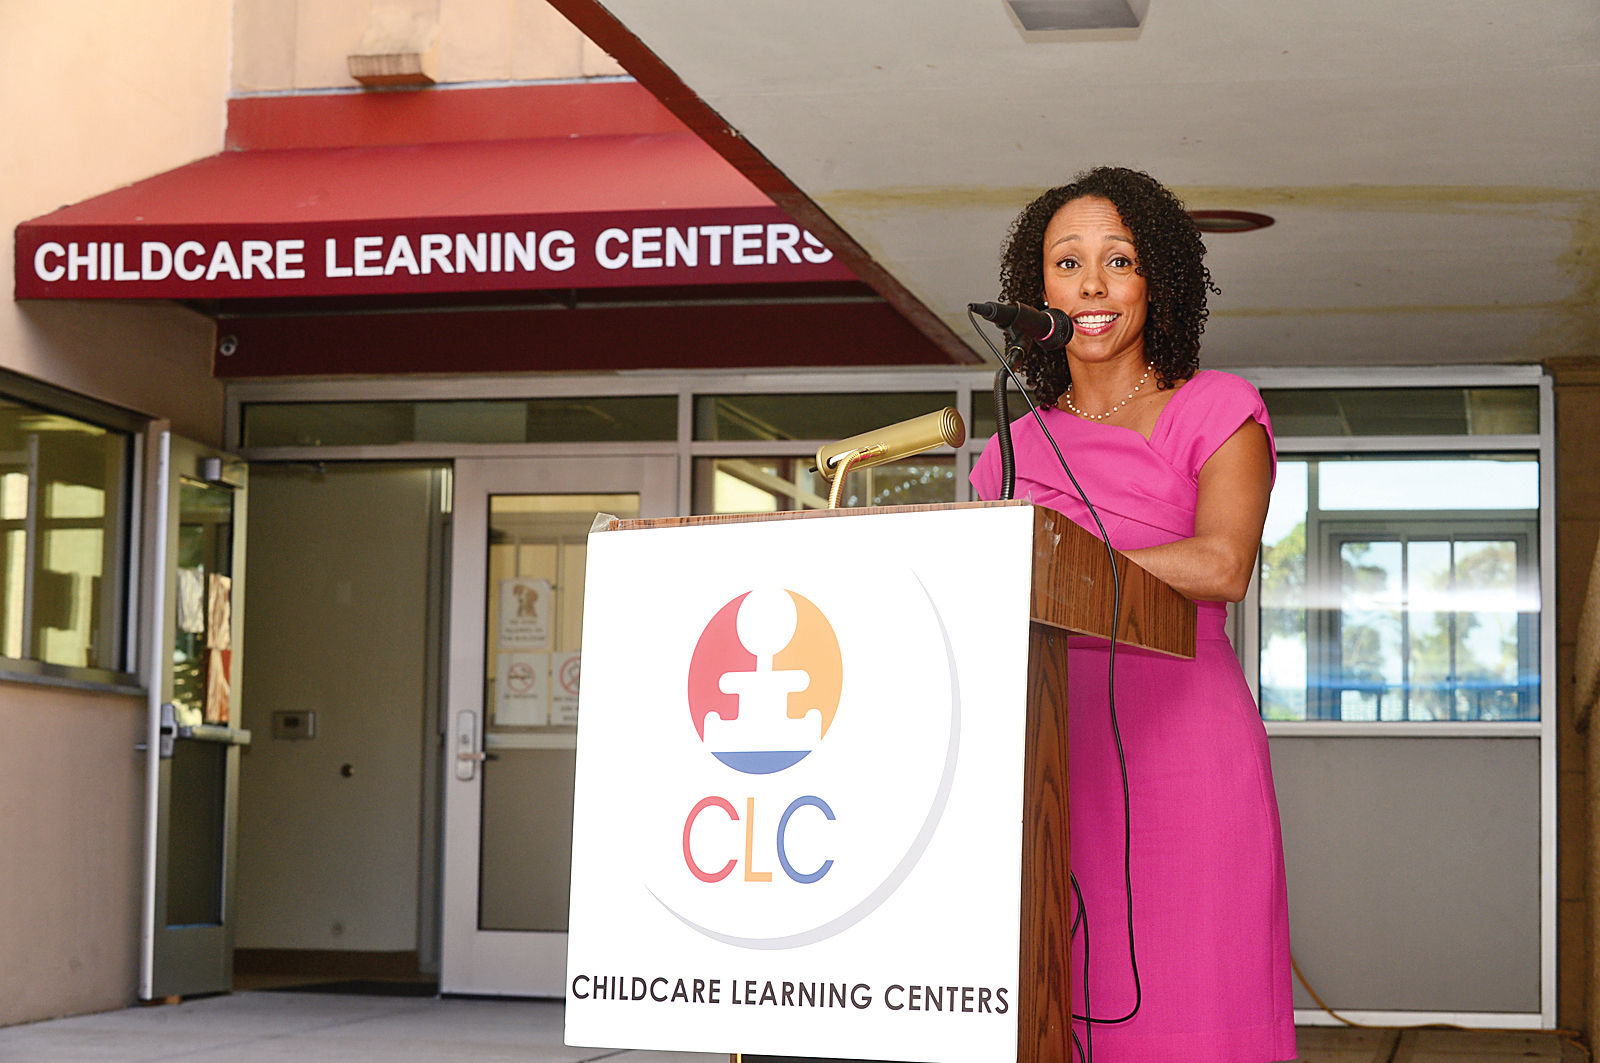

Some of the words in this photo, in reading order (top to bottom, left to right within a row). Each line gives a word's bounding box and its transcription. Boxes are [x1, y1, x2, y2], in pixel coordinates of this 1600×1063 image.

[34, 240, 305, 282] CHILDCARE
[325, 230, 576, 278] LEARNING
[595, 223, 833, 269] CENTERS
[682, 795, 837, 884] CLC
[571, 974, 721, 1004] CHILDCARE
[732, 980, 873, 1009] LEARNING
[884, 984, 1009, 1015] CENTERS
